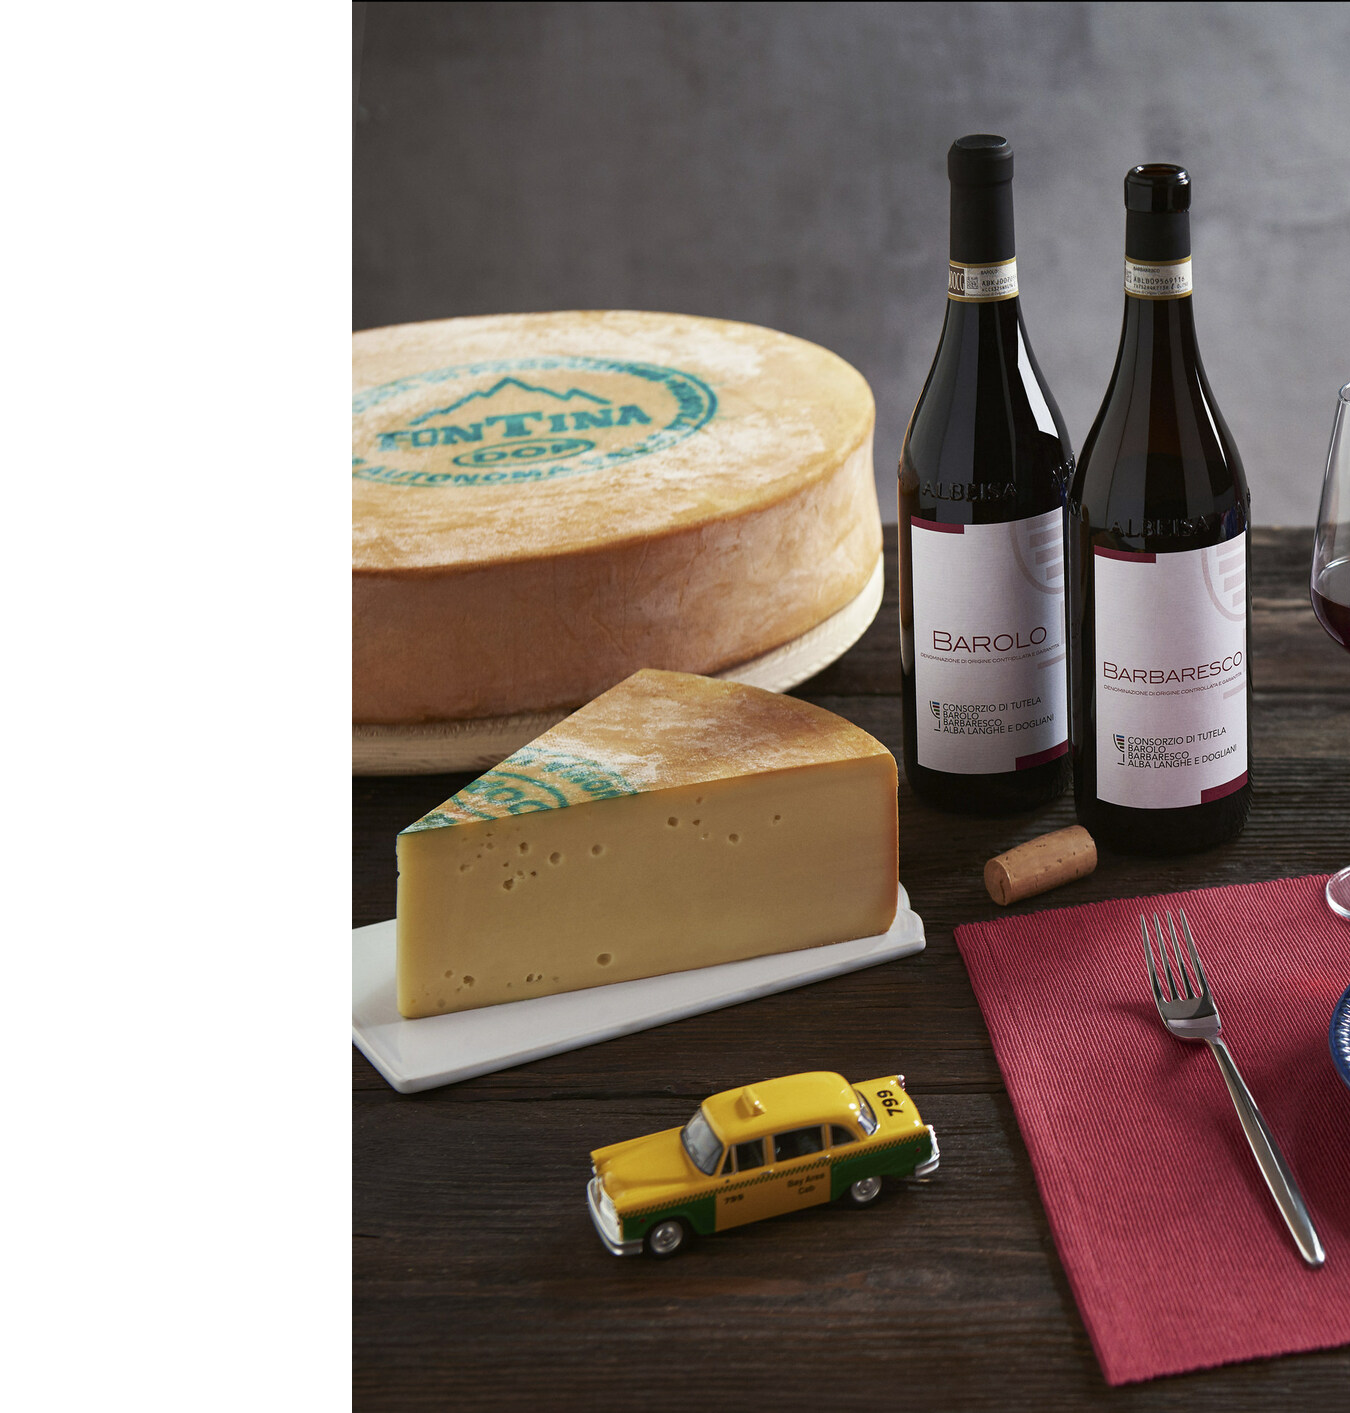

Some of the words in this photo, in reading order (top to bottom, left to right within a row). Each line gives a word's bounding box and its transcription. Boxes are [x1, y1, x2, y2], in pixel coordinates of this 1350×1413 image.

[933, 626, 1047, 653] BAROLO
[920, 652, 961, 664] DENOMINAZIONE
[992, 653, 1031, 663] CONTROLLATA
[1103, 651, 1243, 684] BARBARESCO
[1103, 684, 1148, 696] DENOMINAZIONE
[1180, 683, 1218, 694] CONTROLLATA
[942, 703, 996, 713] CONSORZIO
[998, 702, 1008, 711] DI
[1010, 697, 1042, 710] TUTELA
[943, 711, 979, 720] BAROLO
[943, 718, 1003, 728] BARBARESCO
[943, 725, 966, 735] ALBA
[967, 725, 1006, 735] LANGHE
[1008, 724, 1013, 732] E
[1015, 713, 1055, 731] DOGLIANI
[1127, 736, 1184, 746] CONSORZIO
[1186, 735, 1196, 744] DI
[1198, 727, 1227, 742] TUTELA
[1127, 743, 1167, 753] BAROLO
[1127, 751, 1190, 760] BARBARESCO
[1127, 759, 1151, 768] ALBA
[1153, 758, 1192, 769] LANGHE
[1194, 756, 1200, 765] E
[1201, 743, 1237, 763] DOGLIANI
[877, 1089, 904, 1117] 799
